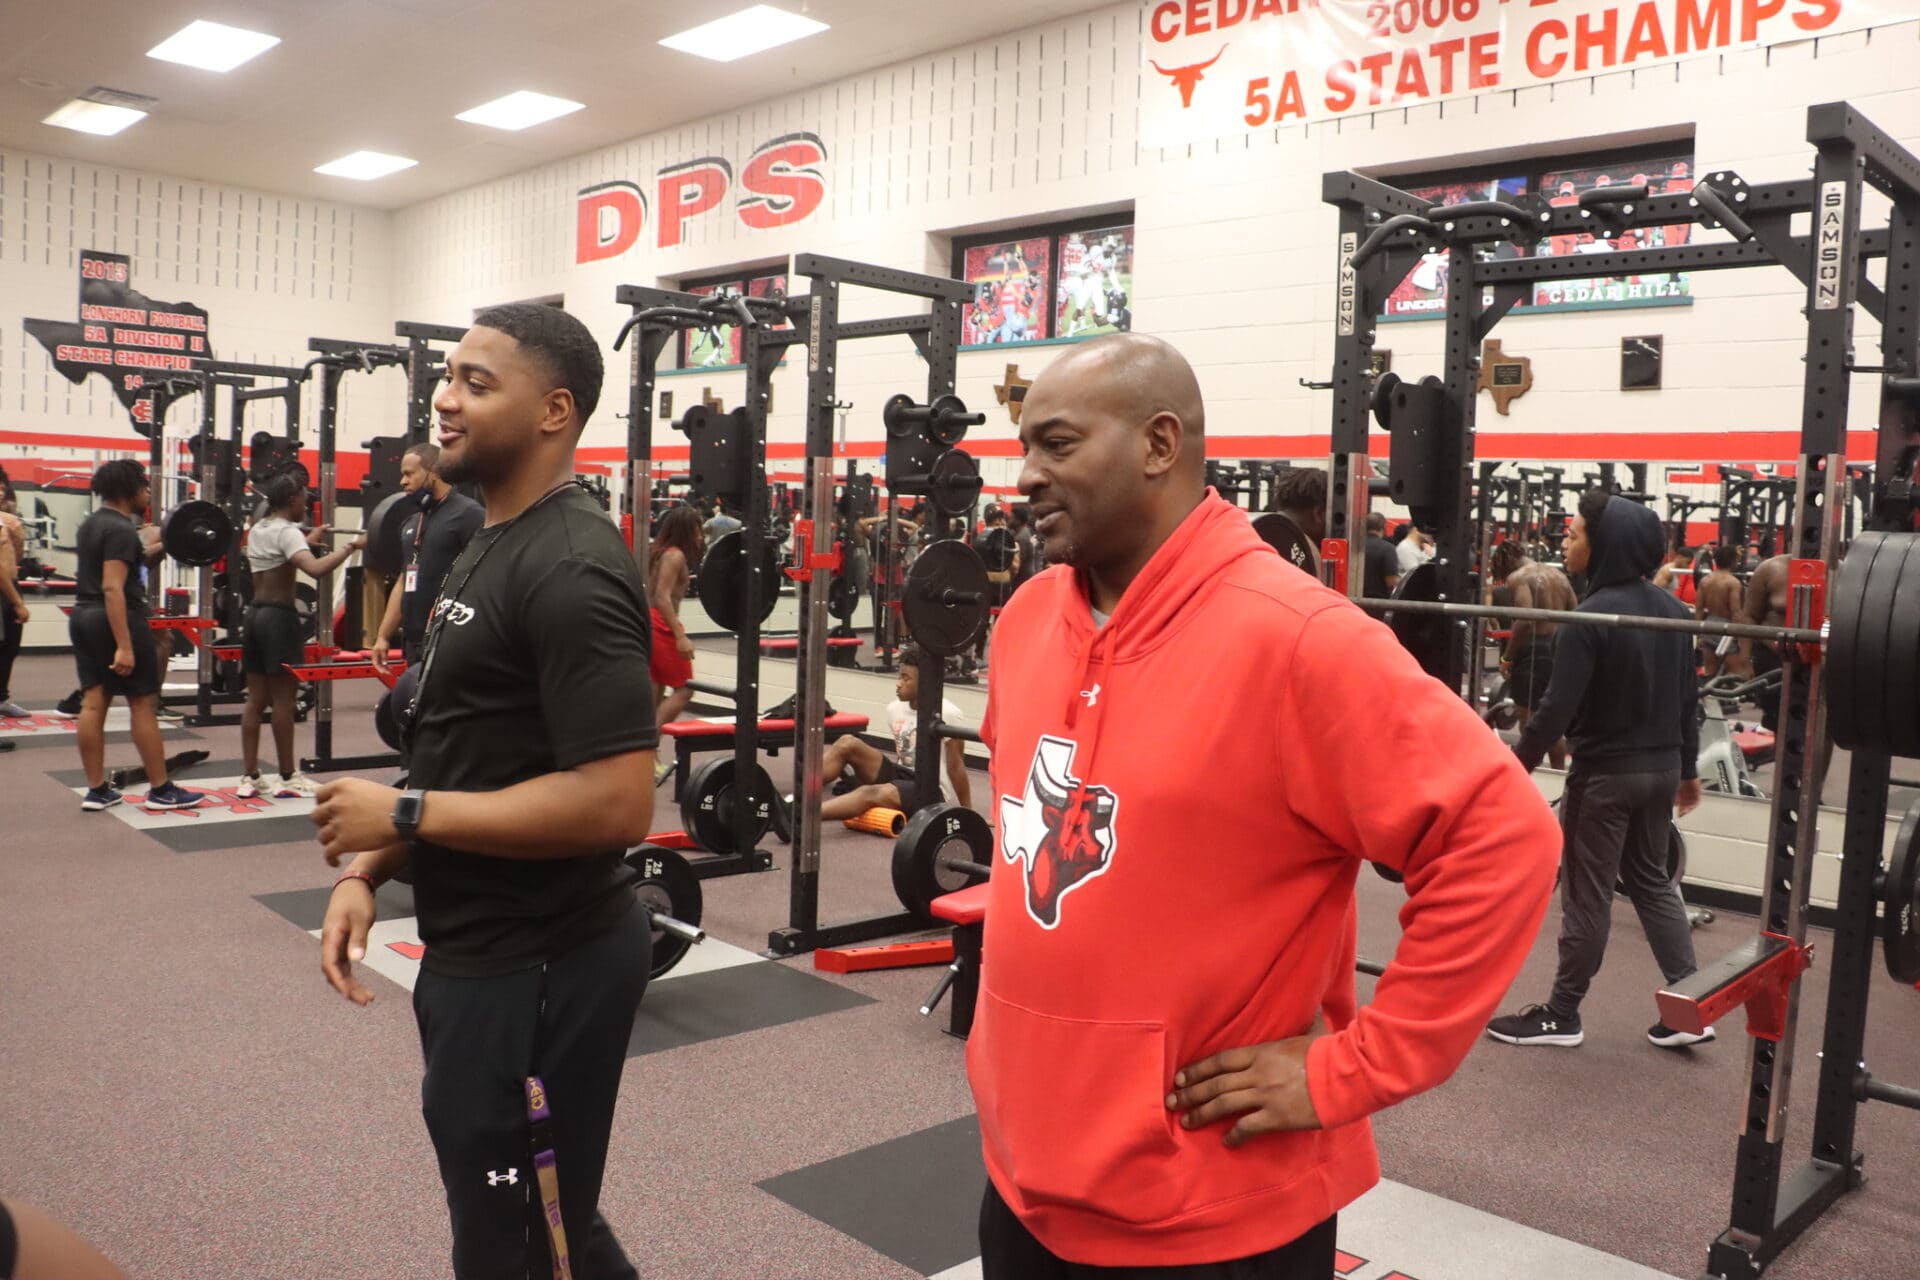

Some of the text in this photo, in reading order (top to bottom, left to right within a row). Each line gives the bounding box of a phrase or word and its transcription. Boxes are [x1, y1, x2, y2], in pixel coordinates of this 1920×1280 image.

[1244, 0, 1842, 127] 5A STATE CHAMPS
[576, 131, 828, 264] DPS
[1818, 193, 1842, 298] SAMSON
[1549, 281, 1681, 304] CEDAR HILL
[81, 304, 206, 331] LONGHORN FOOTBALL
[84, 326, 107, 342] 5A
[113, 328, 185, 349] DIVISION
[57, 345, 192, 370] STATE CHAMPIO
